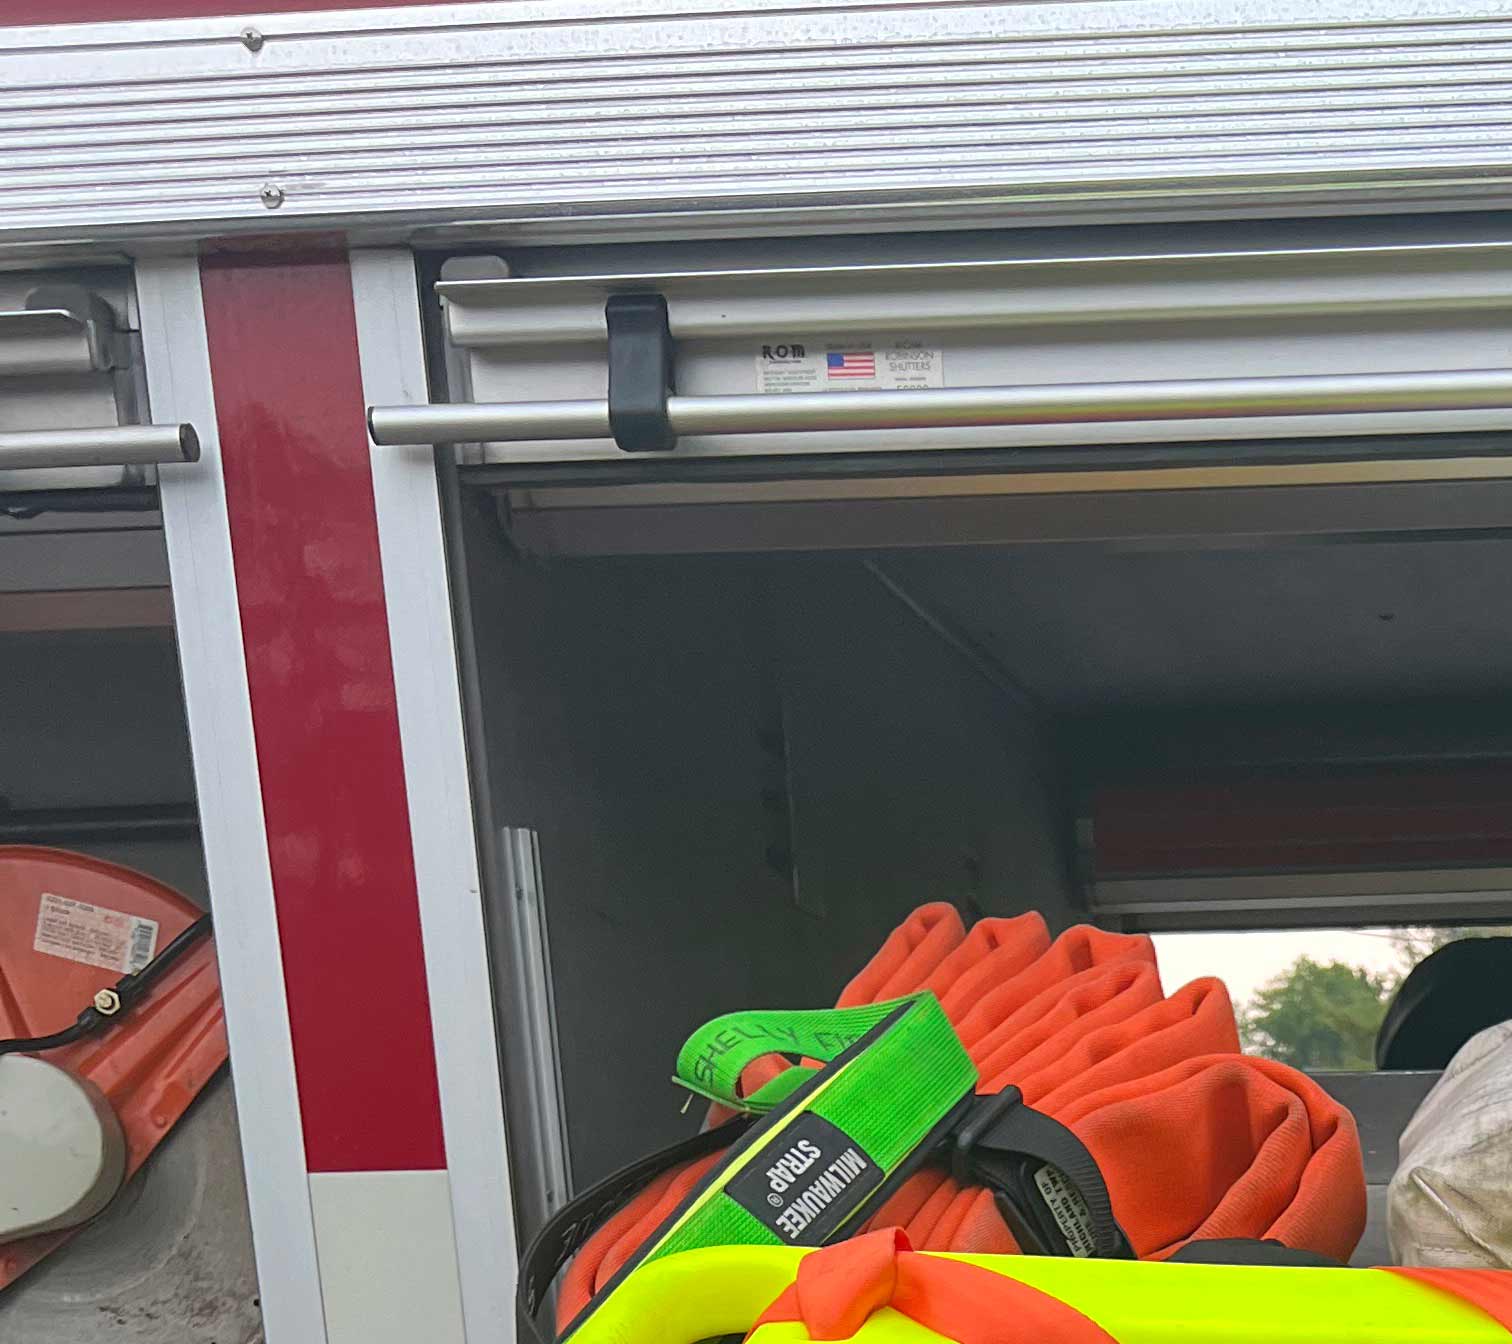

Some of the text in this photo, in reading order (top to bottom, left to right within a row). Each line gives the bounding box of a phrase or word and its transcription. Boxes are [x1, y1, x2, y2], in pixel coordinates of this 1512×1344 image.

[766, 1139, 822, 1193] STRAP
[775, 1147, 868, 1239] MILWAUKEE
[1050, 1198, 1082, 1252] PROPERTY
